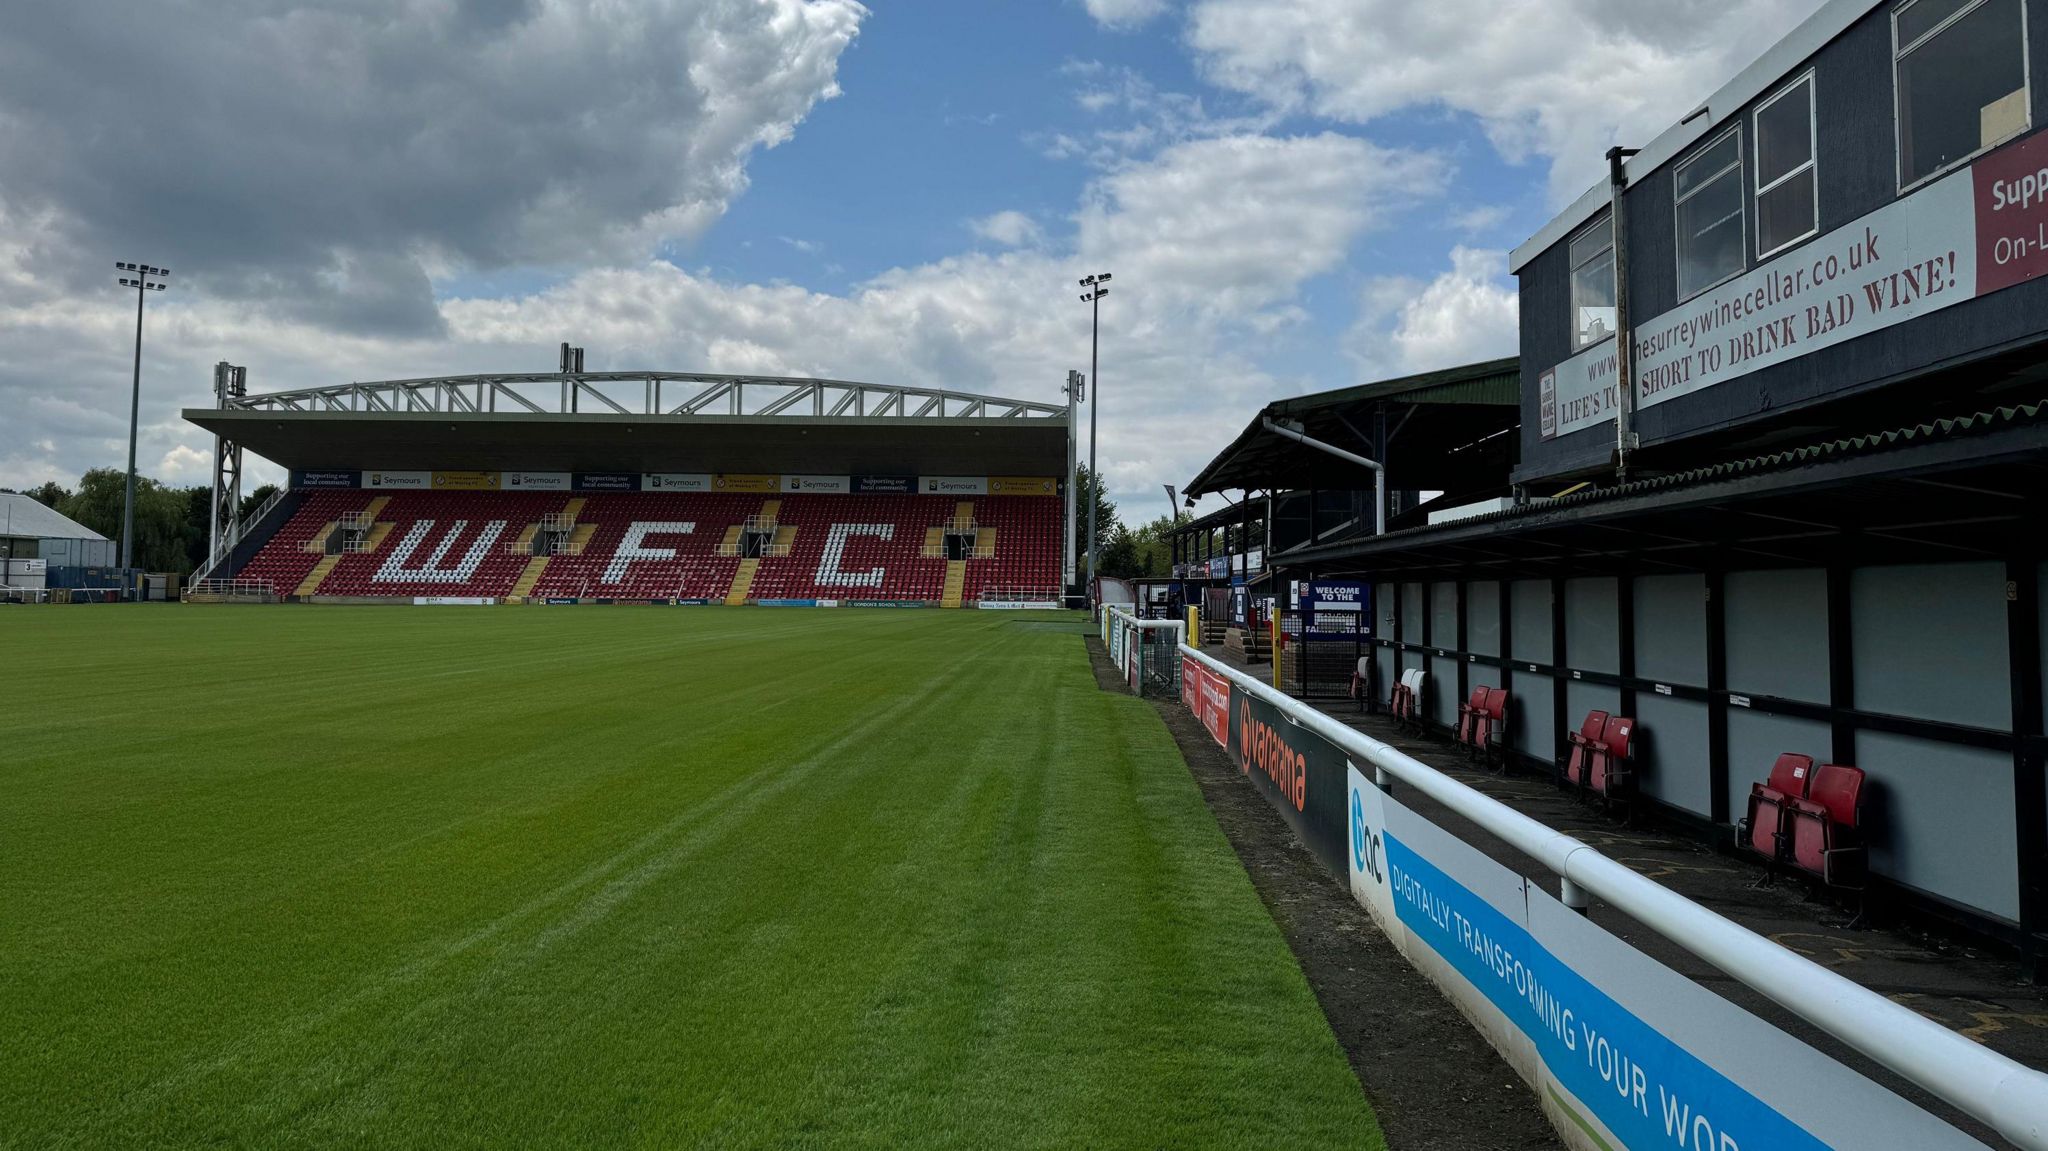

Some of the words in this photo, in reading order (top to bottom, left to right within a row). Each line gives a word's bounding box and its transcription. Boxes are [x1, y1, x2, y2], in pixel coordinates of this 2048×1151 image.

[1561, 392, 1600, 425] LIFE'S
[1641, 355, 1692, 398] SHORT
[1698, 344, 1721, 377] TO
[1728, 314, 1797, 366] DRINK
[1805, 293, 1854, 339] BAD
[1862, 251, 1956, 314] WINE!
[384, 476, 421, 486] Seymours
[524, 476, 561, 486] Seymours
[664, 478, 701, 488] Seymours
[803, 480, 840, 489] Seymours
[940, 481, 977, 491] Seymours
[1252, 718, 1306, 812] vanarama
[1393, 864, 1450, 932] DIGITALLY
[1454, 911, 1575, 1051] TRANSFORMING
[1582, 1021, 1649, 1118] YOUR
